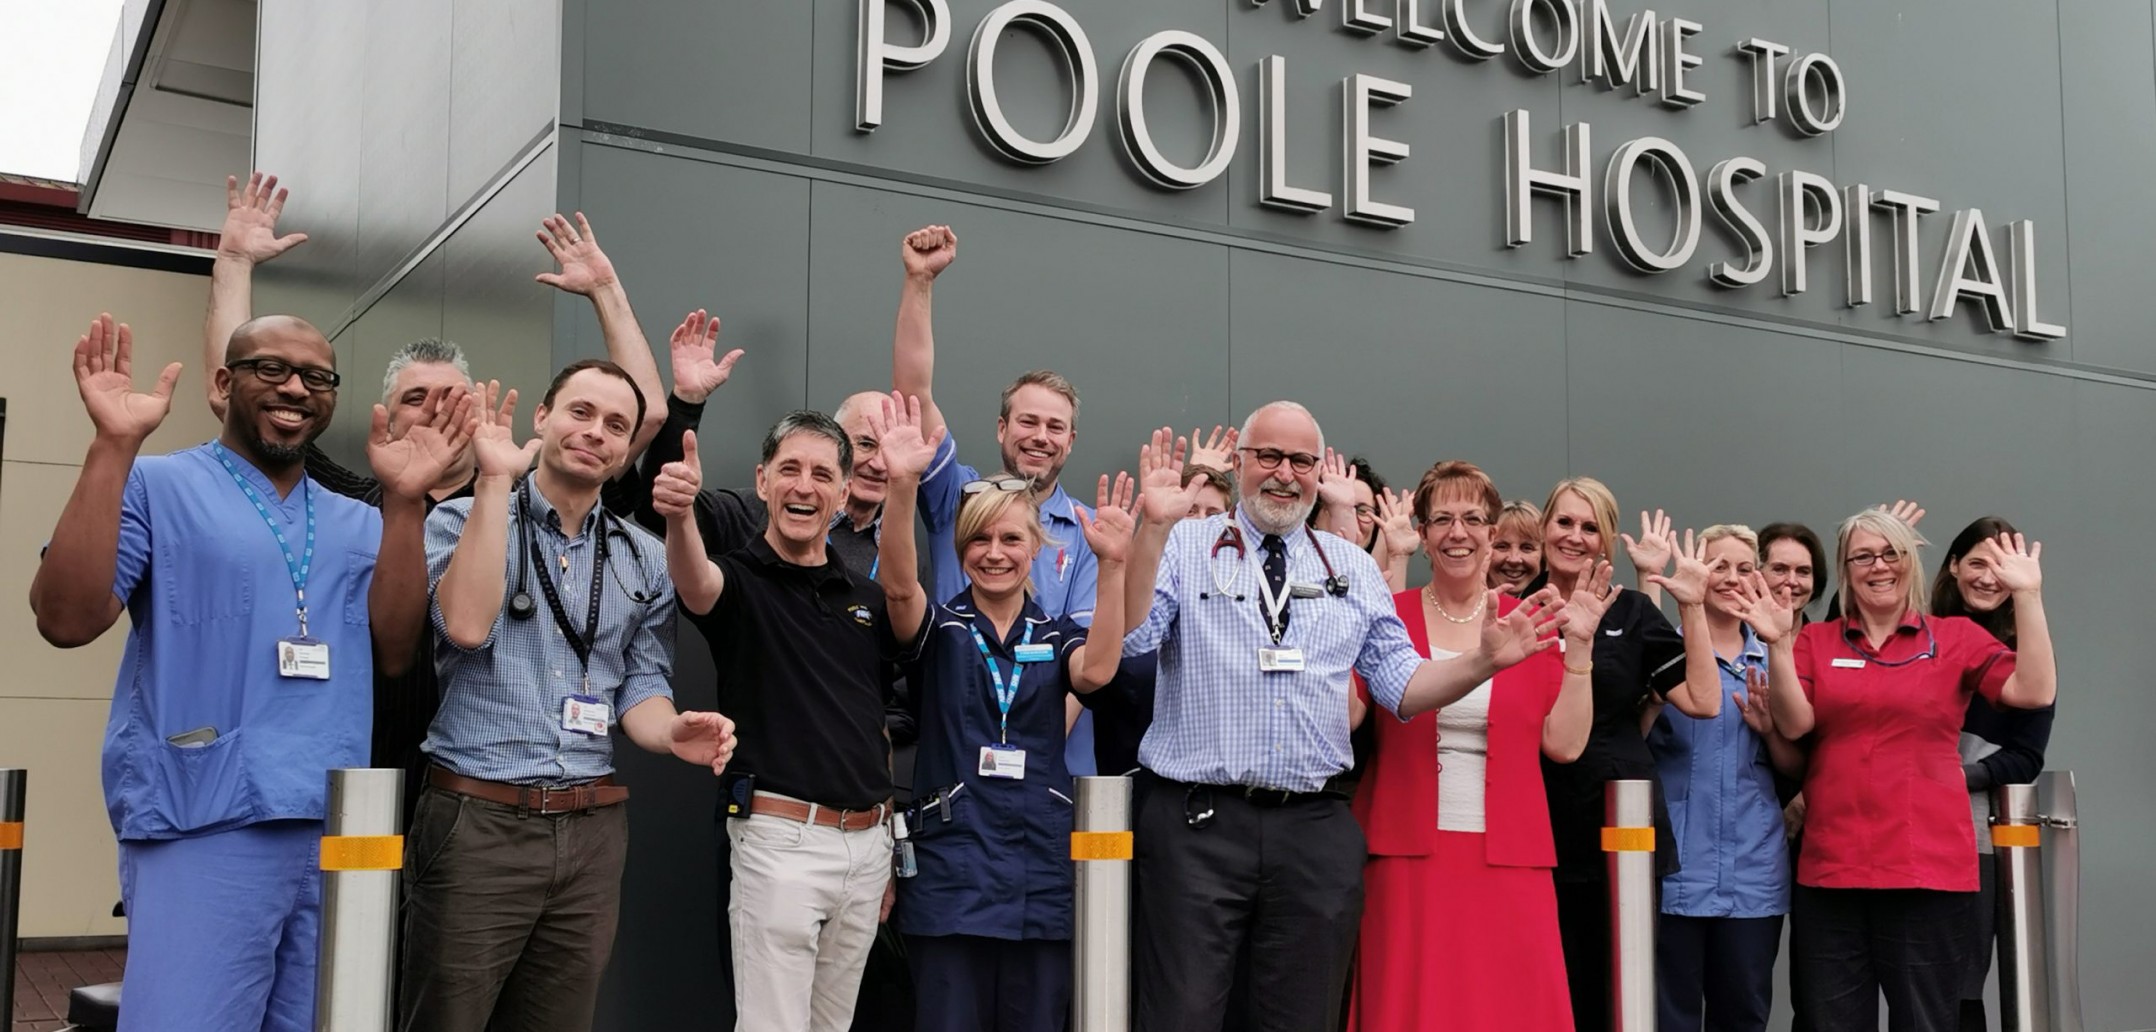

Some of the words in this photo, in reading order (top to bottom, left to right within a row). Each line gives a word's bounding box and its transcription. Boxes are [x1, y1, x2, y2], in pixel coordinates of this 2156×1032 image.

[856, 0, 1415, 229] POOLE
[1504, 108, 2067, 341] HOSPITAL
[1253, 0, 1706, 108] LCOME
[1737, 37, 1846, 136] TO
